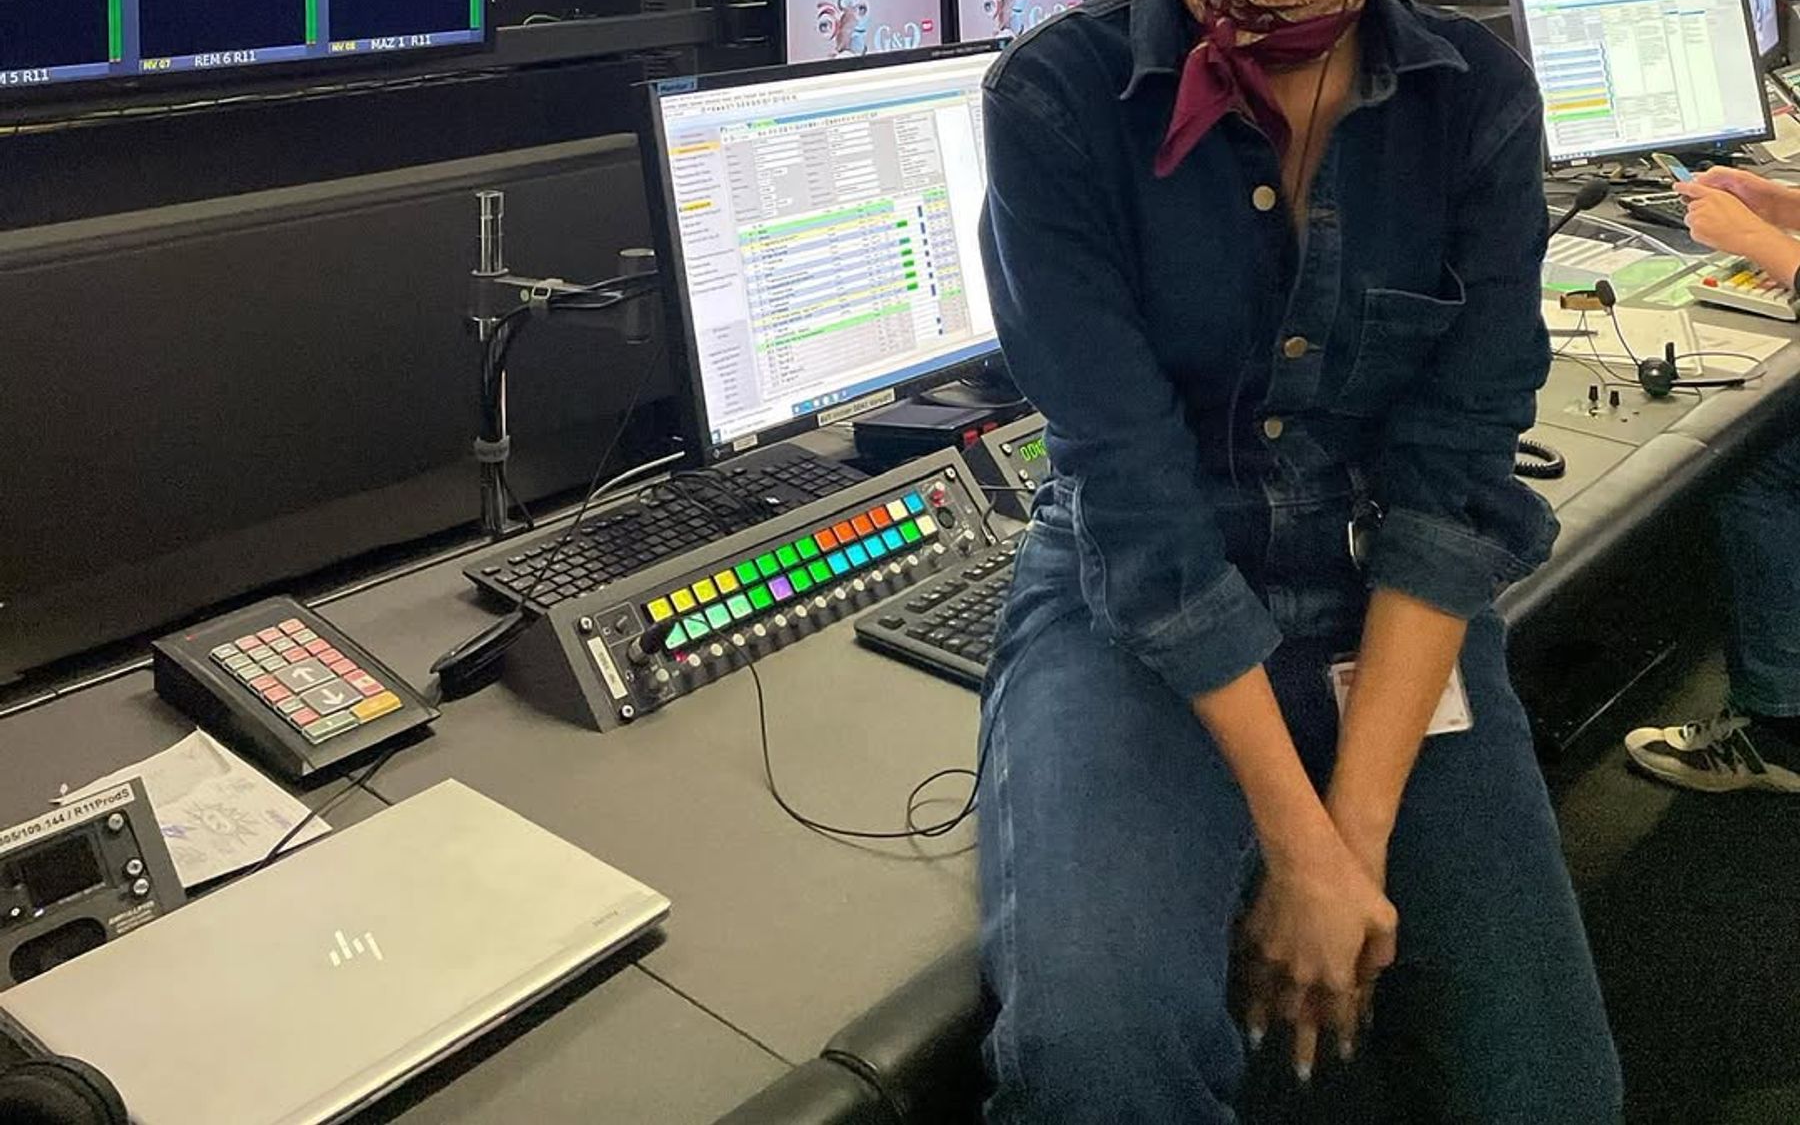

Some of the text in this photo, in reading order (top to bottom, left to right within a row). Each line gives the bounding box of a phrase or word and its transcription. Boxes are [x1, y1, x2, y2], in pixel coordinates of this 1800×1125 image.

[371, 37, 395, 49] MAZ
[195, 50, 257, 67] REM 6 R11
[10, 71, 18, 83] 5
[23, 68, 50, 83] R11
[74, 788, 130, 817] R11ProdS
